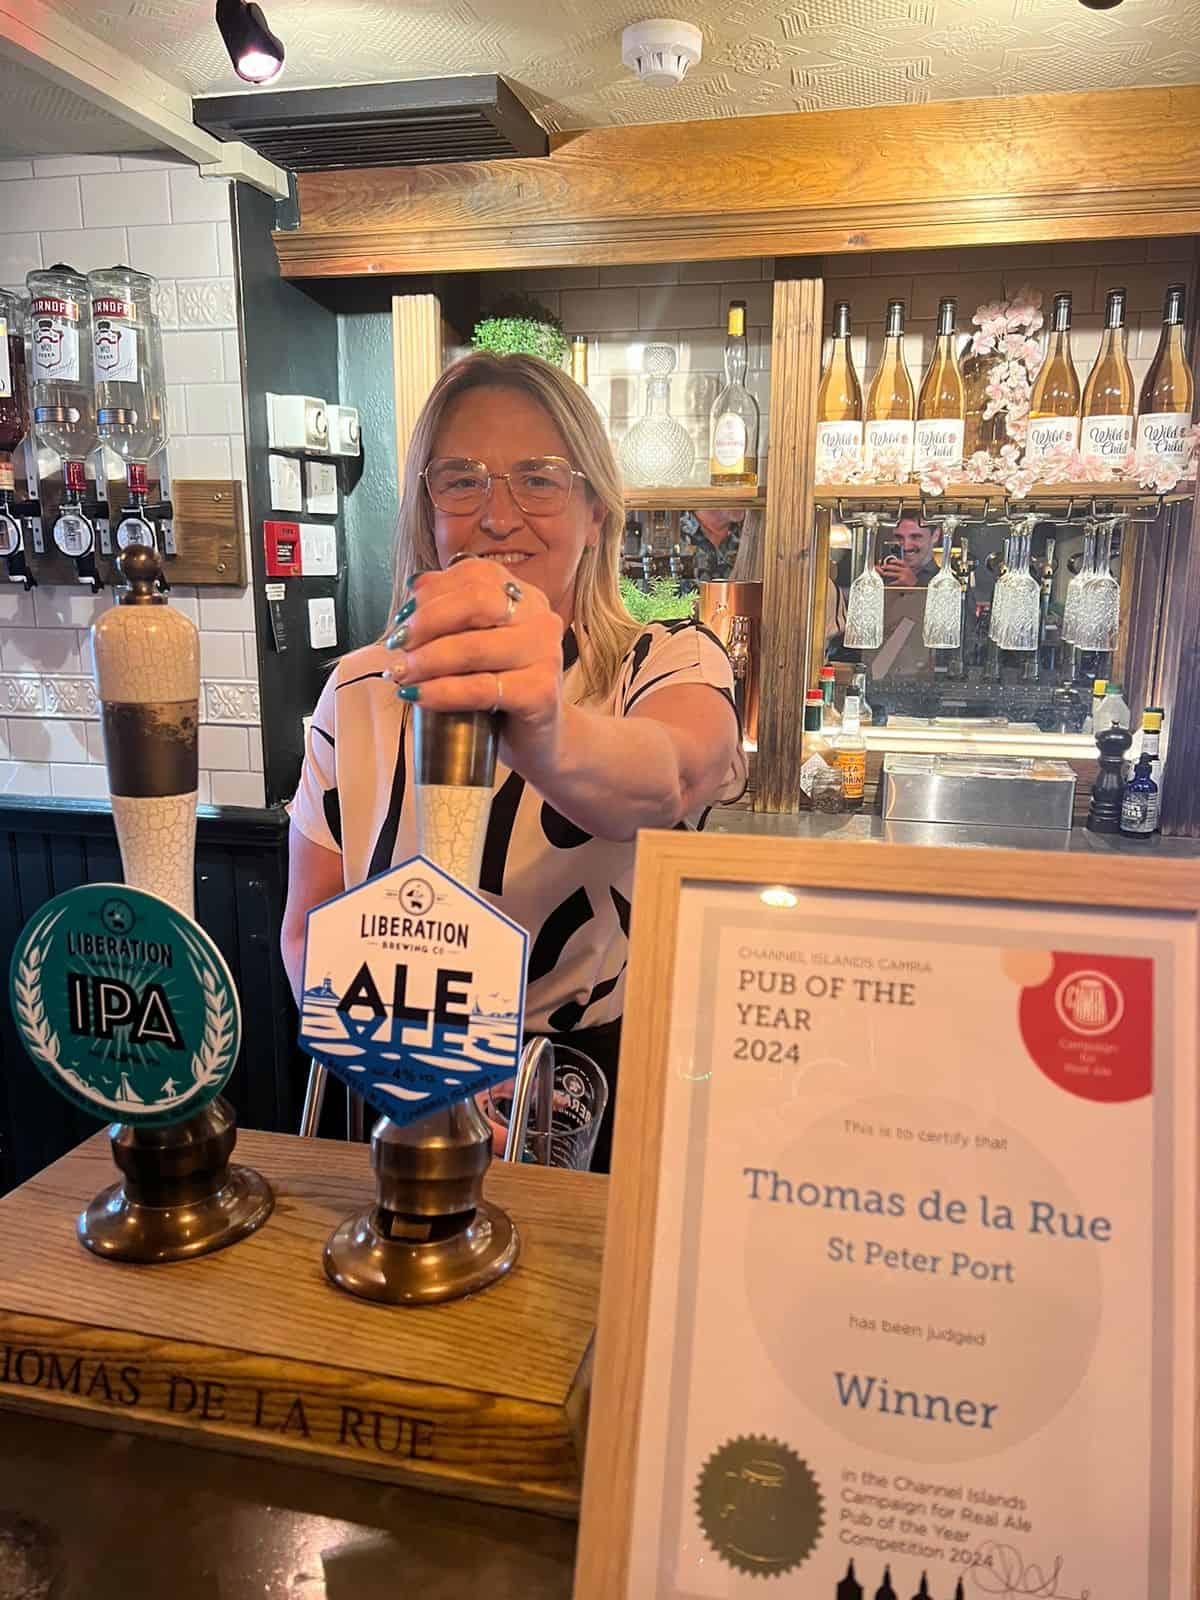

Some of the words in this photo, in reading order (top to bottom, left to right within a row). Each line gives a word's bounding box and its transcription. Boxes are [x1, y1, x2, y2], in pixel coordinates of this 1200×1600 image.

[822, 432, 851, 447] Wild
[918, 431, 947, 447] Wild
[1032, 429, 1062, 445] Wild
[1090, 426, 1121, 443] Wild
[1102, 441, 1127, 455] Child
[1144, 424, 1177, 441] Wild
[1155, 438, 1185, 453] Child
[360, 913, 469, 949] LIBERATION
[382, 941, 428, 953] BREWING
[67, 930, 173, 968] LIBERATION
[738, 946, 807, 964] CHANNEL
[811, 951, 873, 969] ISLANDS
[335, 961, 473, 1027] ALE
[738, 968, 797, 995] PUB
[805, 975, 845, 999] OF
[853, 978, 917, 1006] THE
[67, 972, 185, 1050] IPA
[736, 1002, 811, 1031] YEAR
[733, 1037, 800, 1064] 2024
[843, 1119, 873, 1136] This
[878, 1123, 890, 1138] is
[896, 1126, 912, 1141] to
[917, 1127, 969, 1149] certify
[975, 1133, 1008, 1151] that
[743, 1167, 905, 1218] Thomas
[918, 1190, 968, 1224] de
[981, 1195, 1015, 1231] la
[1029, 1200, 1112, 1242] Rue
[827, 1236, 855, 1263] St
[864, 1240, 942, 1274] Peter
[950, 1252, 1015, 1283] Port
[848, 1313, 876, 1330] has
[881, 1319, 923, 1337] been
[926, 1325, 986, 1347] judged
[833, 1370, 998, 1429] Winner
[166, 1374, 226, 1421] DE
[252, 1387, 312, 1439] LA
[338, 1403, 438, 1462] RUE
[841, 1468, 857, 1483] in
[861, 1470, 888, 1489] the
[893, 1475, 963, 1501] Channel
[967, 1487, 1027, 1512] Islands
[839, 1507, 873, 1528] Pub
[877, 1515, 896, 1530] of
[900, 1518, 927, 1537] the
[934, 1525, 970, 1543] Year
[840, 1487, 927, 1517] Campaign
[931, 1502, 955, 1520] for
[961, 1506, 999, 1527] Real
[1004, 1515, 1032, 1534] Ale
[838, 1528, 944, 1560] Competition
[948, 1548, 994, 1568] 2024
